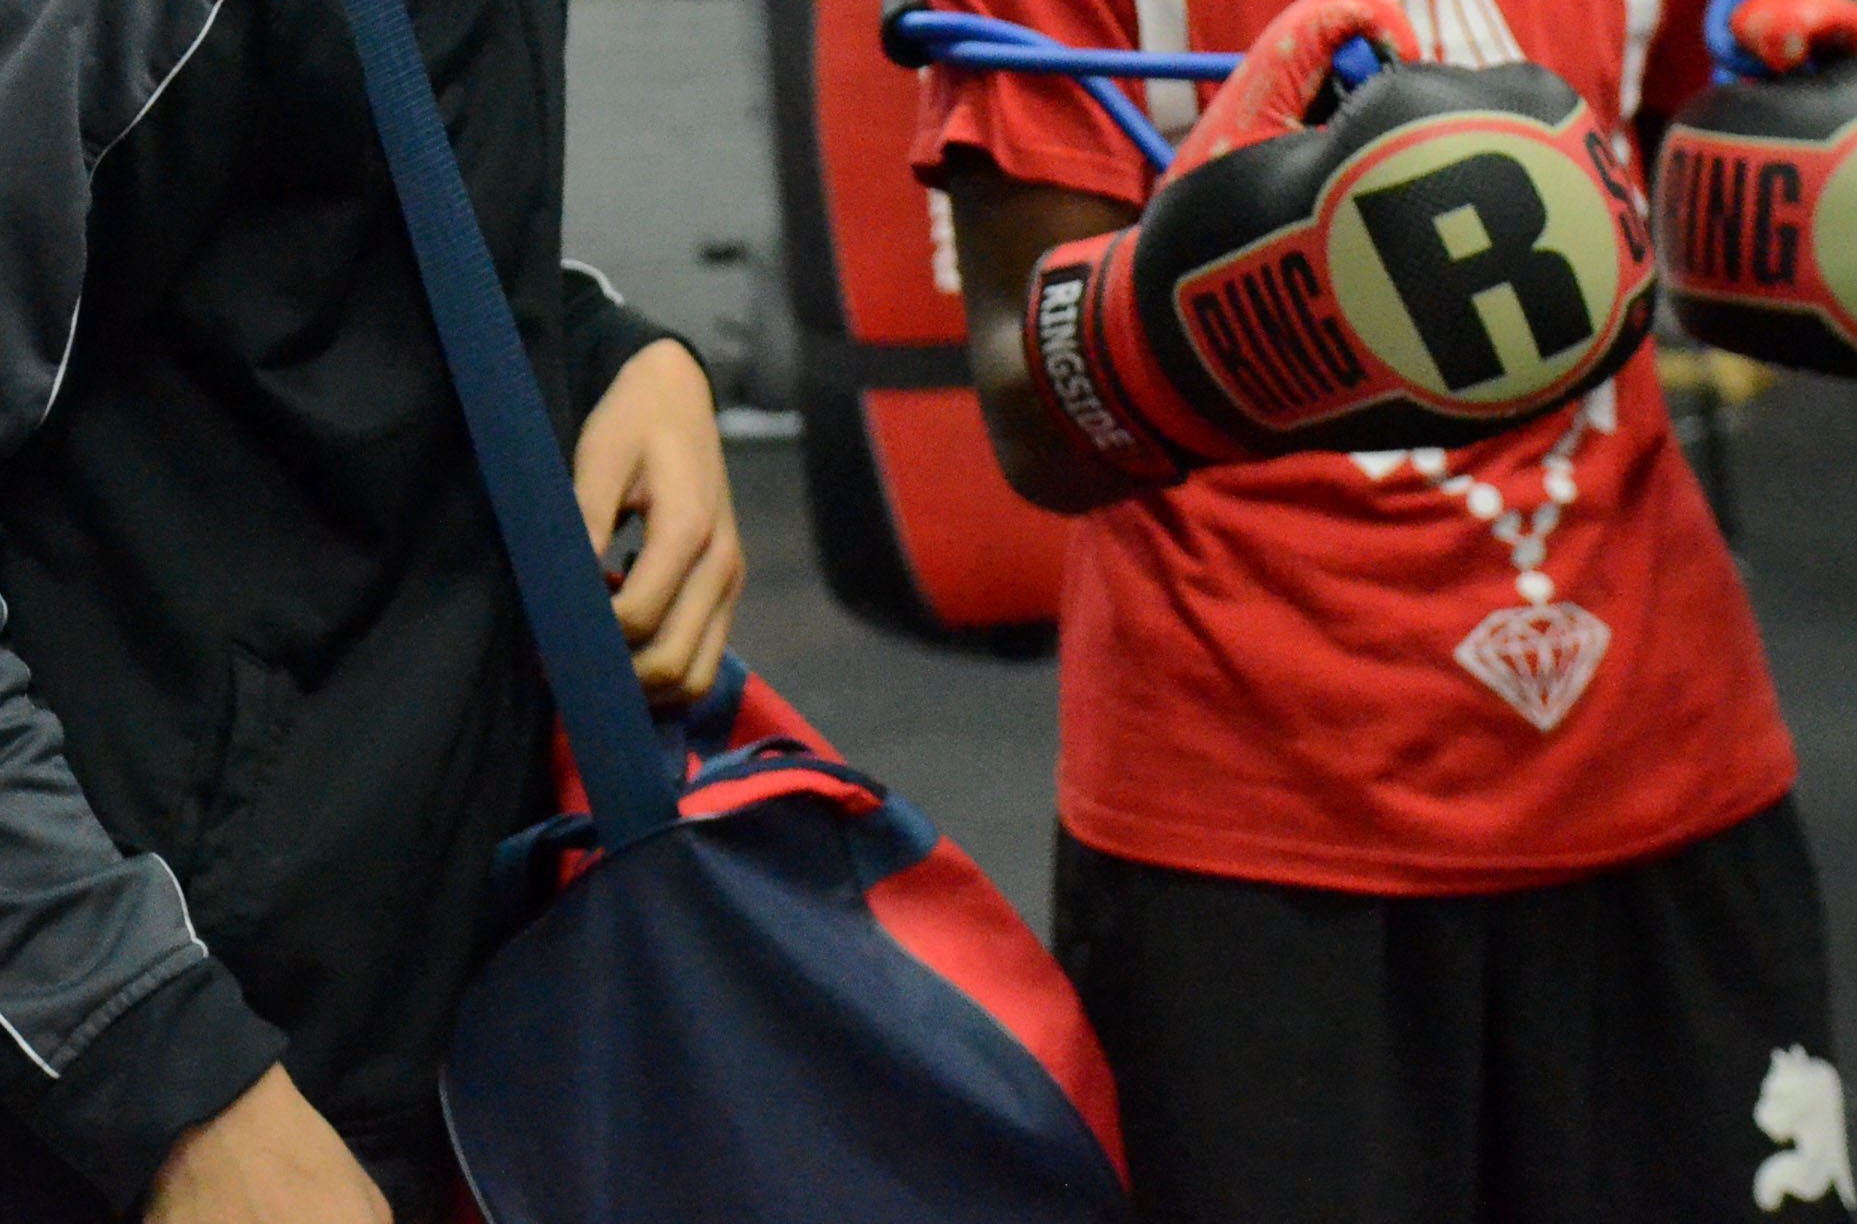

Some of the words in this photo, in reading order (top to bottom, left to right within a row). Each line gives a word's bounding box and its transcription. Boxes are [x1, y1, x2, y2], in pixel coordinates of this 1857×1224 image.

[1040, 278, 1136, 451] RINGSIDE
[1191, 250, 1371, 414] RING
[1352, 151, 1595, 392] R
